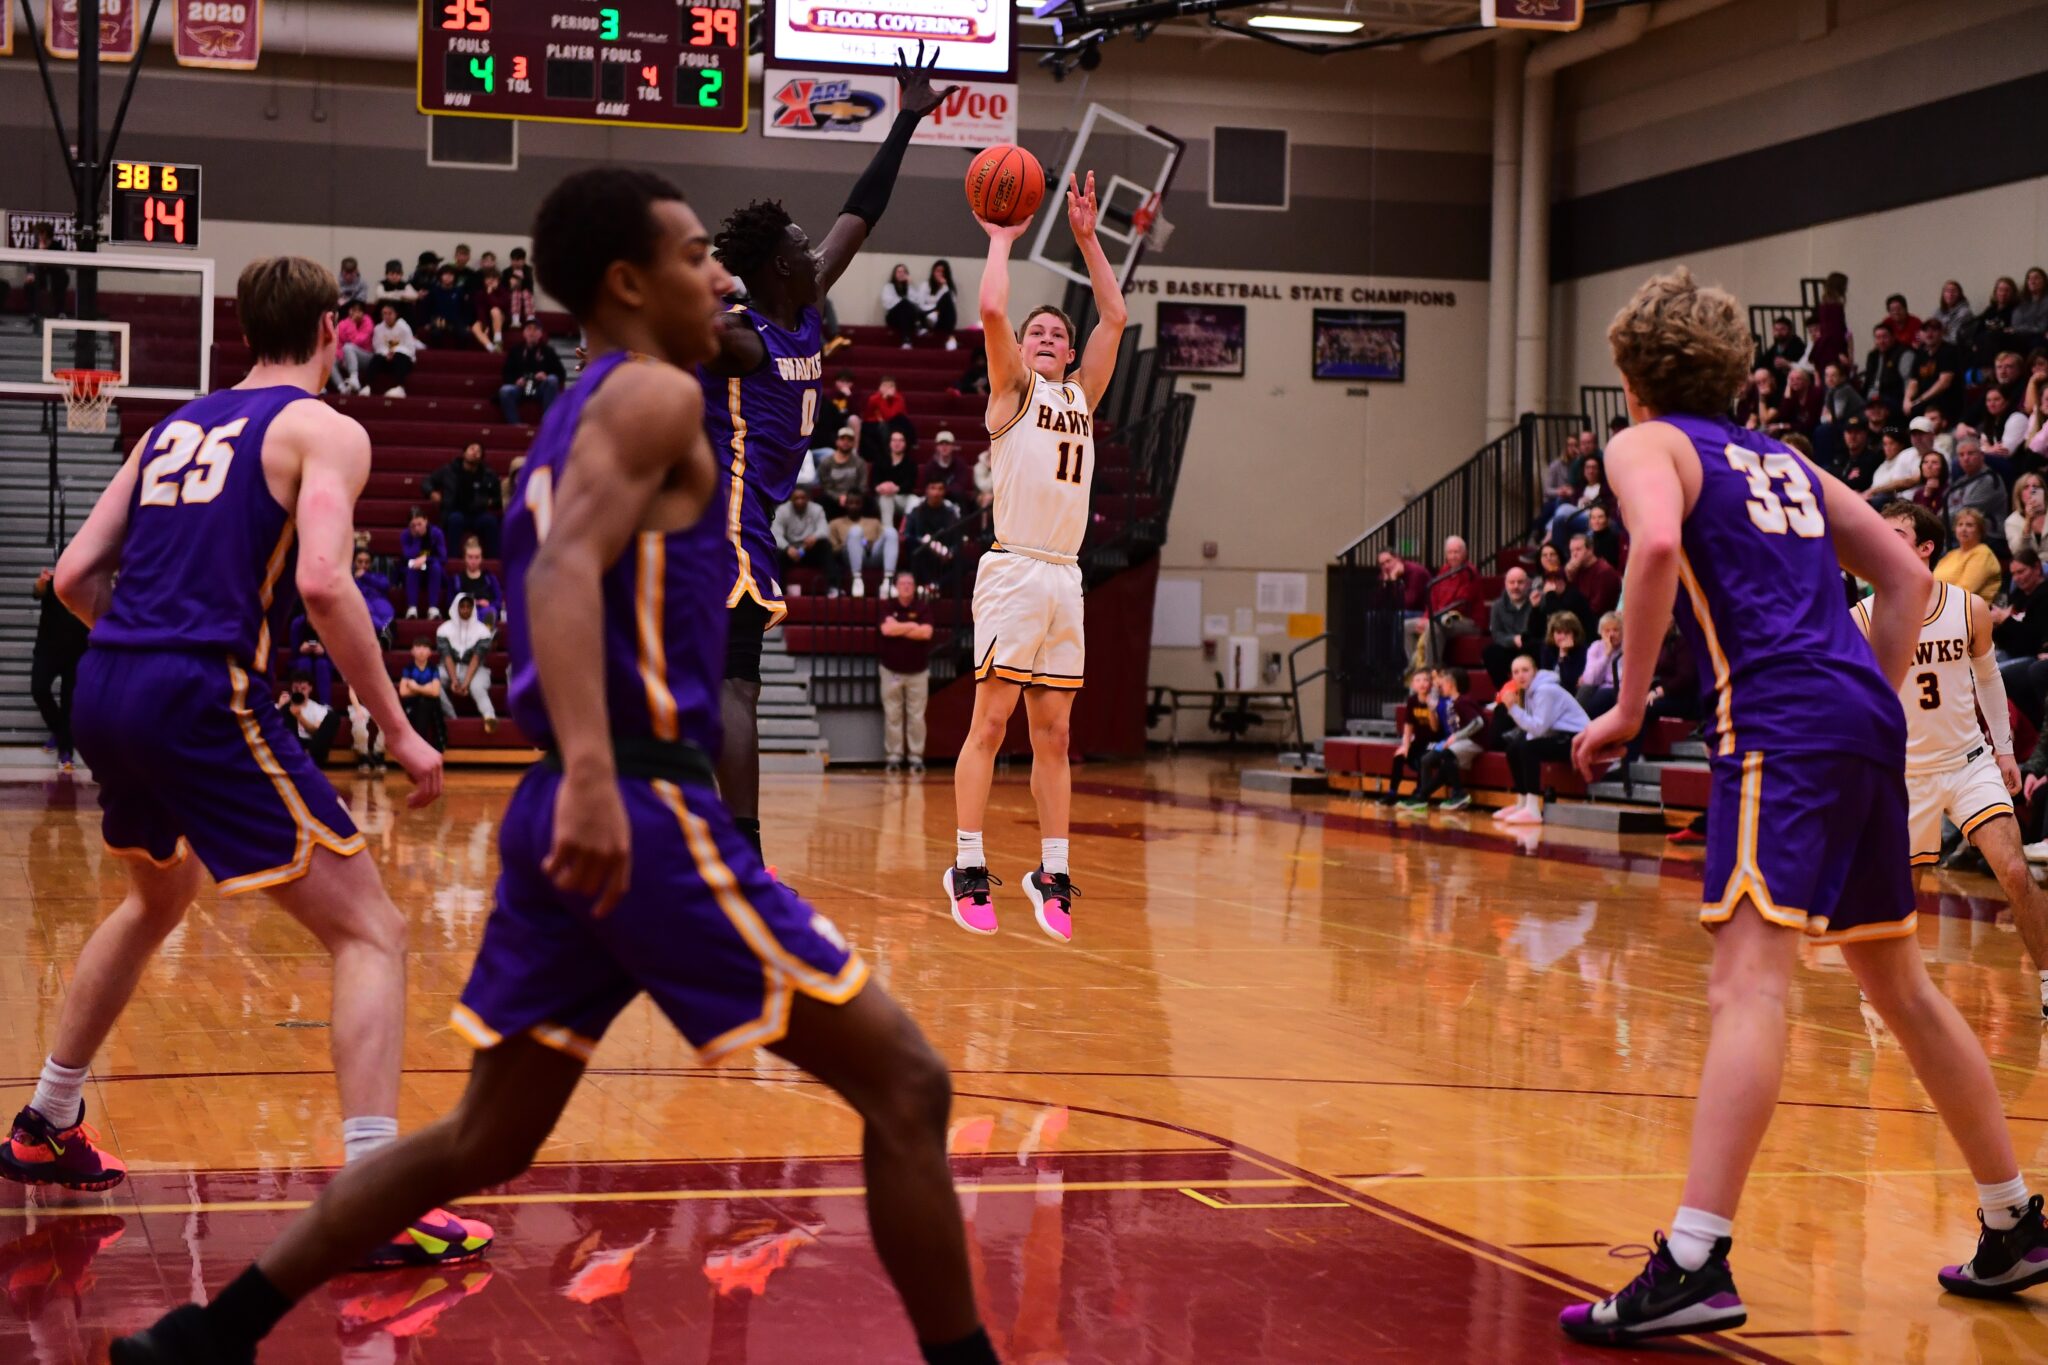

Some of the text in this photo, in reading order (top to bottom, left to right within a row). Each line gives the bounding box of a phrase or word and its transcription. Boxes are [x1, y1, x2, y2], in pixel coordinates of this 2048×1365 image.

[188, 2, 246, 24] 2020
[442, 0, 490, 31] 35
[551, 8, 619, 40] PERIOD 3
[690, 8, 736, 46] 39
[816, 9, 969, 35] FLOOR COVERING
[449, 37, 490, 53] FOULS
[546, 43, 642, 63] PLAYER FOULS
[470, 55, 493, 93] 4
[512, 56, 527, 79] 3
[679, 52, 719, 68] FOULS
[507, 78, 532, 93] TOL
[641, 65, 657, 86] 4
[699, 69, 722, 107] 2
[444, 92, 471, 106] WON
[637, 86, 662, 101] TOL
[596, 102, 630, 116] GAME
[116, 163, 178, 192] 38 6
[991, 167, 1010, 213] LEGACY
[144, 196, 185, 243] 14
[1122, 280, 1458, 308] OYS BASKETBALL STATE CHAMPIONS
[800, 388, 817, 437] 0
[140, 417, 249, 506] 25
[1056, 441, 1084, 485] 11
[1724, 442, 1825, 538] 33
[1911, 638, 1964, 667] WKS
[1916, 672, 1941, 710] 3
